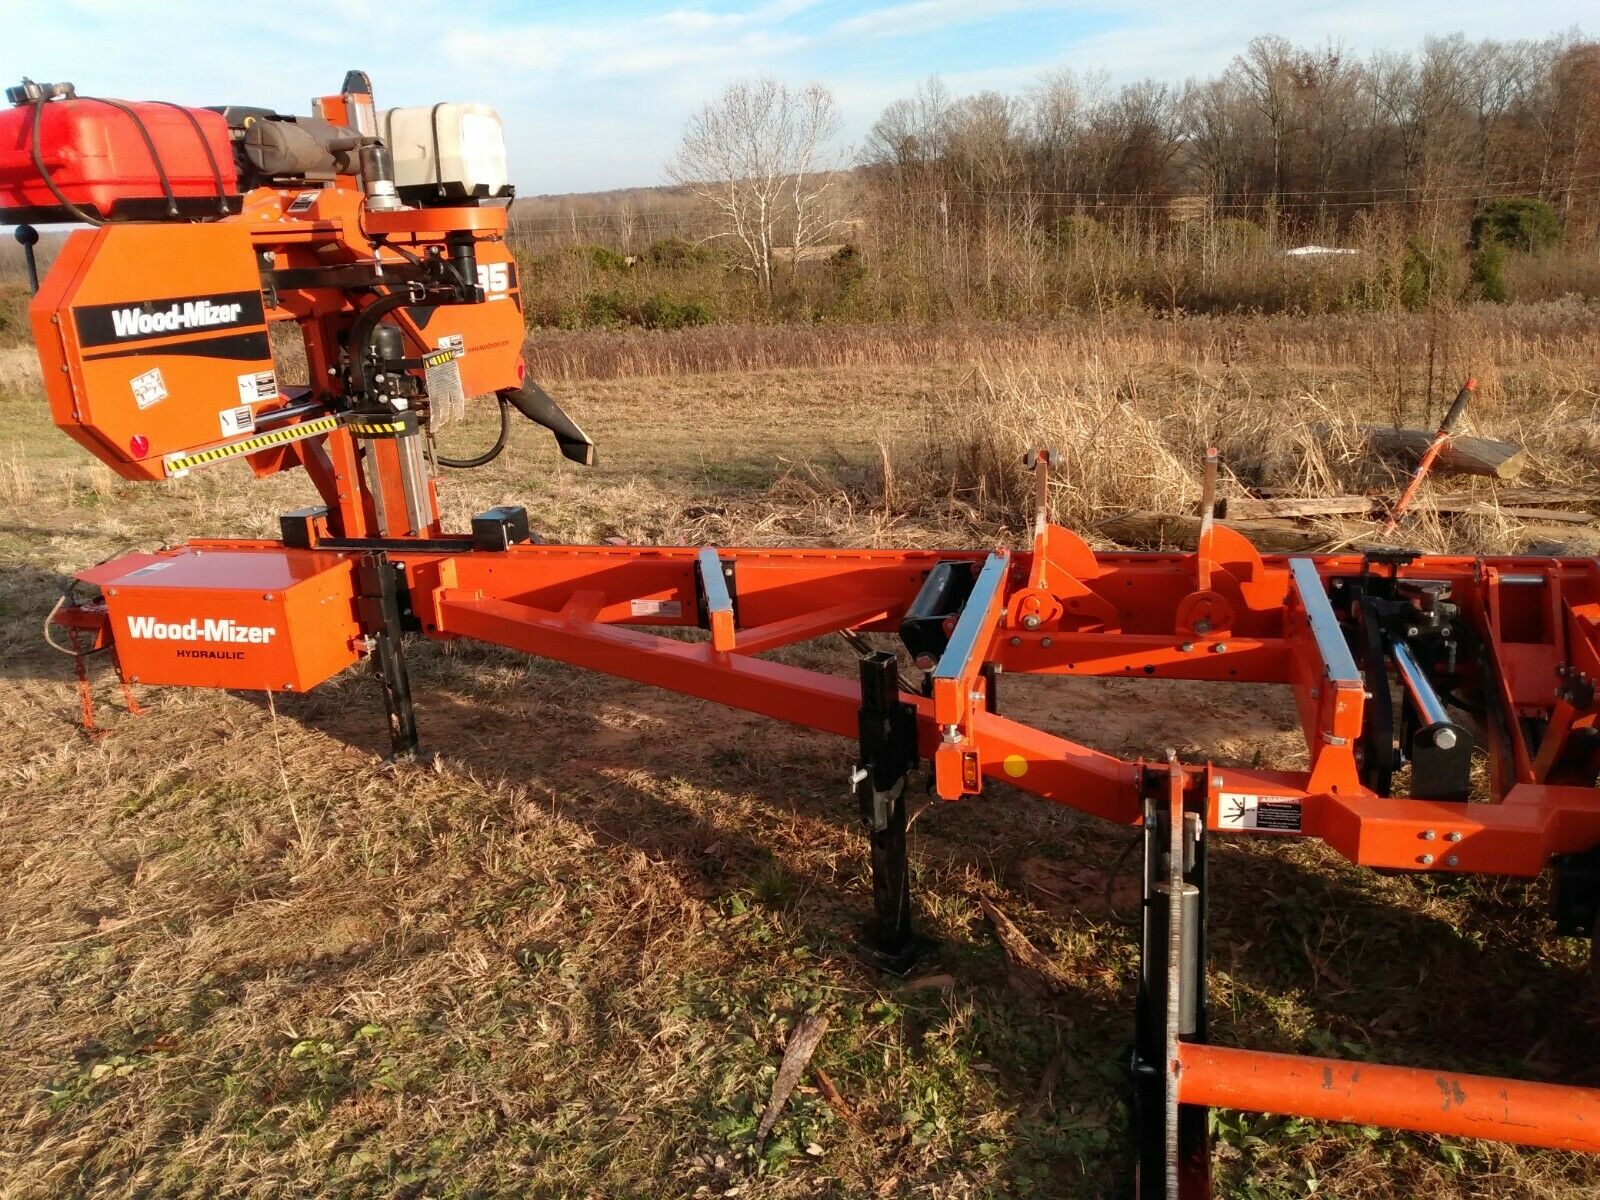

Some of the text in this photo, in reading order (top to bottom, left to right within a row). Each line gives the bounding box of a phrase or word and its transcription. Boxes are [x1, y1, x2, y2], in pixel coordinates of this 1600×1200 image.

[111, 300, 242, 337] Wood-Mizer
[127, 615, 276, 644] Wood-Mizer
[176, 649, 246, 660] HYDRAULIC
